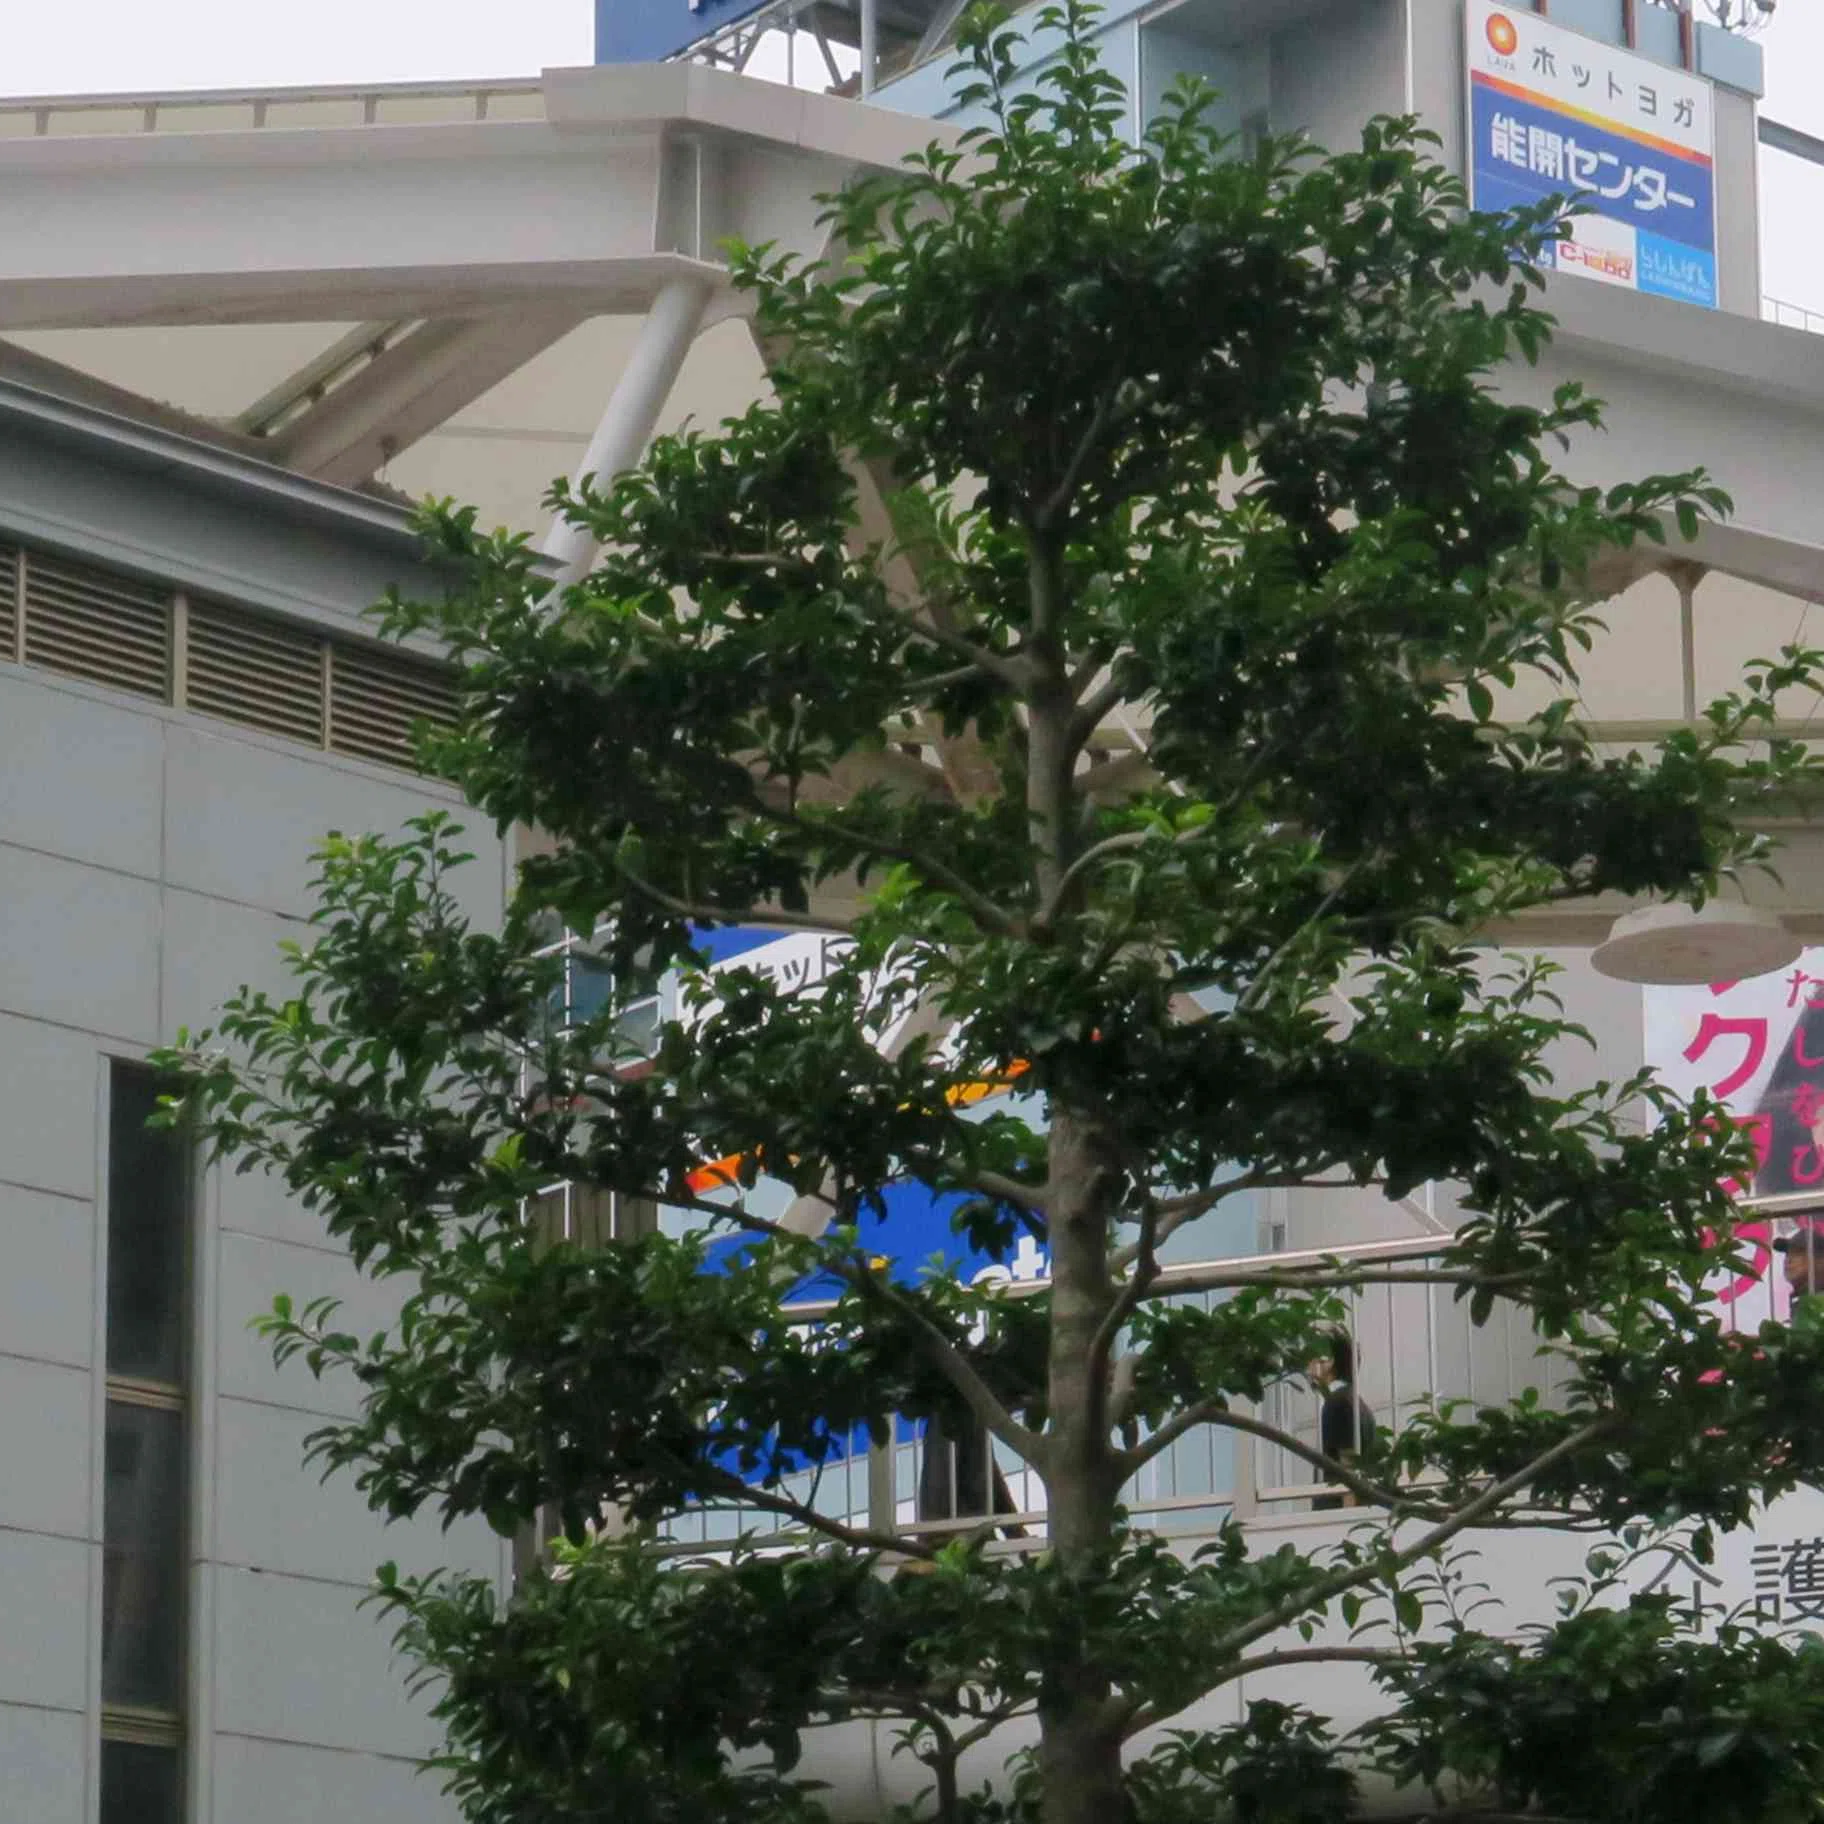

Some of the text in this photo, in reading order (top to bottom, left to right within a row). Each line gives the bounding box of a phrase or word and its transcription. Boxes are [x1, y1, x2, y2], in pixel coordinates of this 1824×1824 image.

[1532, 46, 1696, 129] ホットヨガ
[1491, 111, 1696, 210] 能開センター
